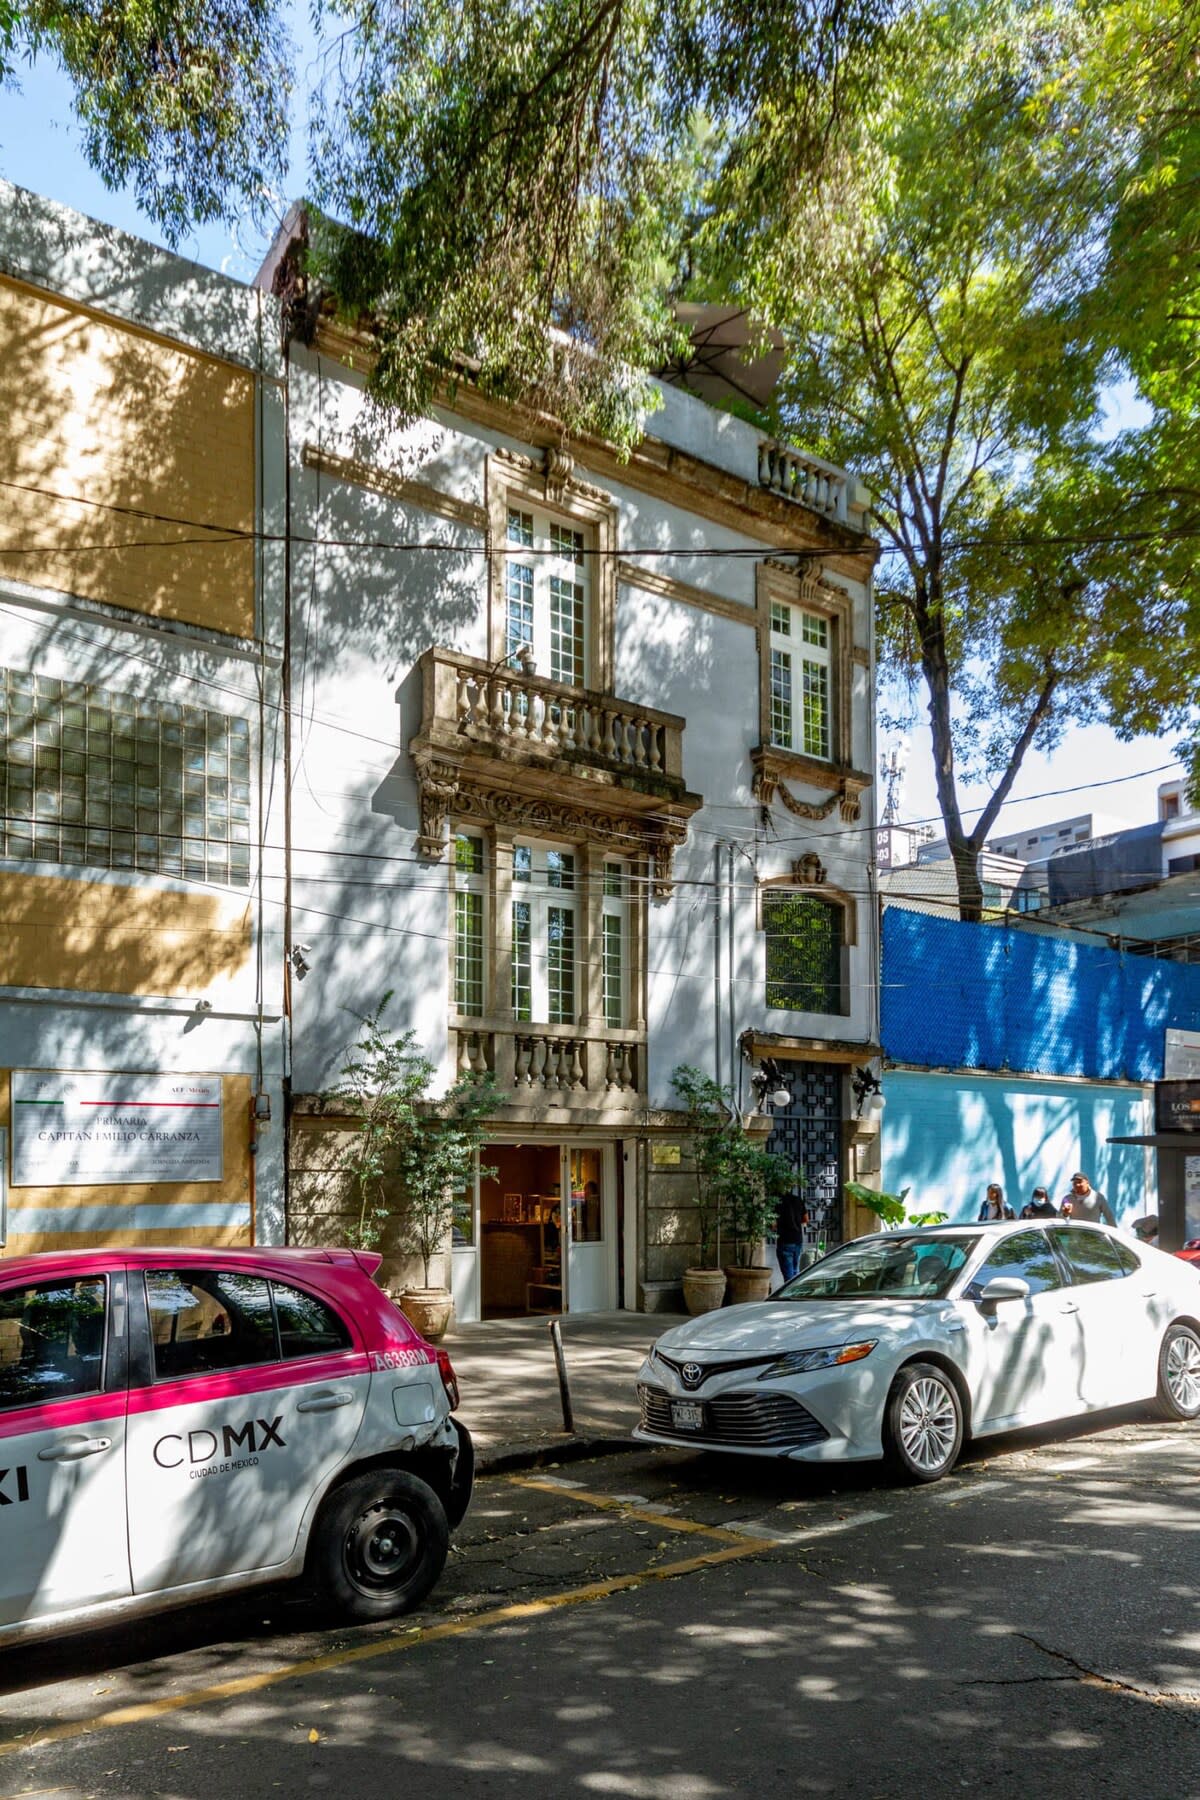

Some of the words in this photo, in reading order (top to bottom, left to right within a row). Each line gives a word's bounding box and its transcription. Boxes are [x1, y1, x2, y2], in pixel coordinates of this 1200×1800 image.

[96, 1117, 147, 1126] PRIMARIA
[38, 1130, 92, 1141] CAPITÁN
[96, 1131, 137, 1141] EMILIO
[139, 1131, 200, 1142] CARRANZA
[375, 1348, 430, 1371] A6388M
[153, 1416, 287, 1468] CDMX
[189, 1465, 218, 1479] CIUDAD
[220, 1463, 230, 1473] DE
